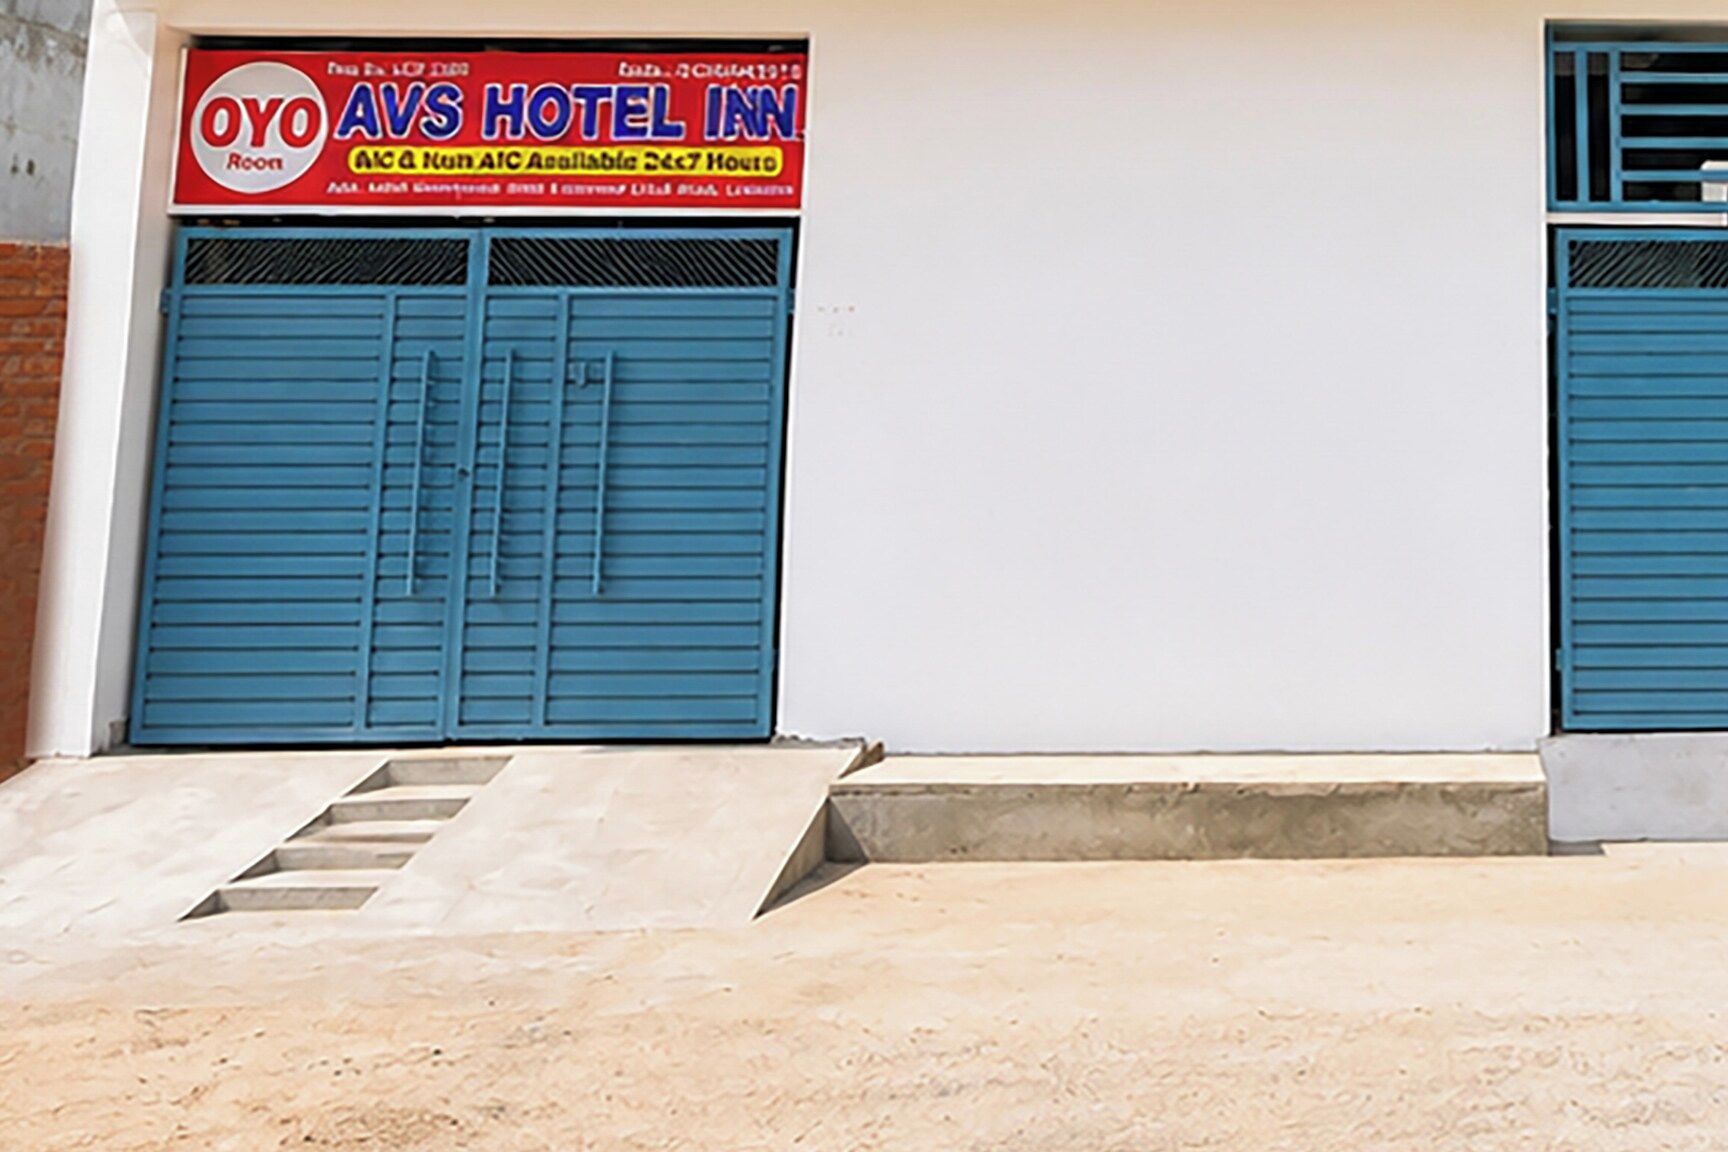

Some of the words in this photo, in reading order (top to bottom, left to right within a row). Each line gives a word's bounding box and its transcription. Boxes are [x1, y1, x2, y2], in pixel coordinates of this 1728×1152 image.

[200, 96, 321, 149] OYO
[333, 81, 463, 141] AVS
[481, 83, 686, 141] HOTEL
[703, 83, 798, 141] INN
